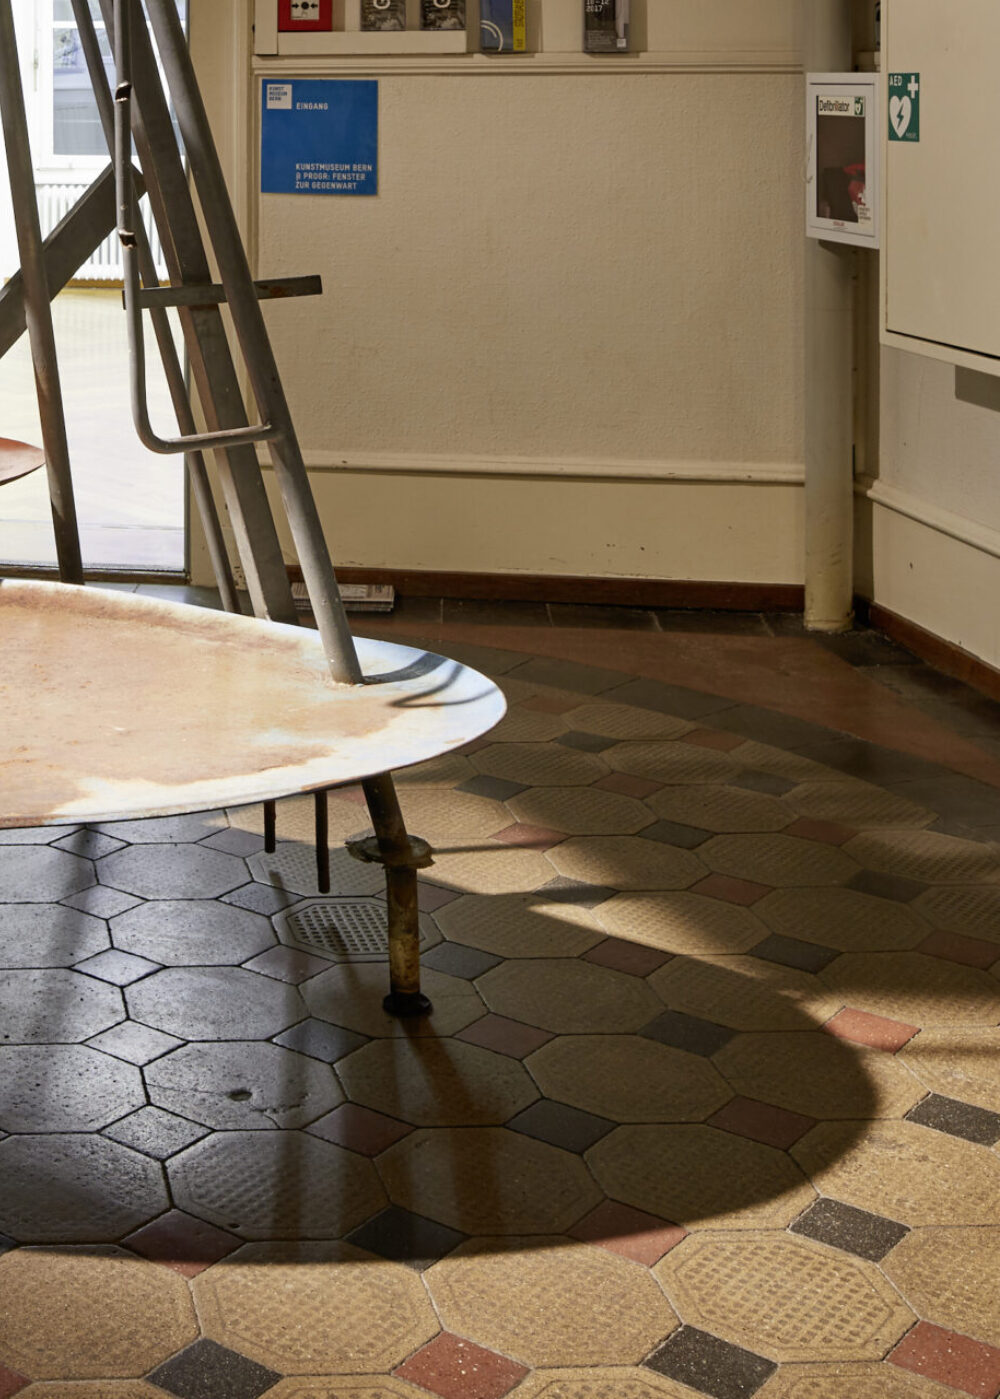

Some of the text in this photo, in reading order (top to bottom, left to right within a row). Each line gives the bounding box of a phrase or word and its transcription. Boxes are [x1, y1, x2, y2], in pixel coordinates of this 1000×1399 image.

[889, 75, 903, 86] AED
[296, 102, 329, 111] EINGANG
[819, 99, 850, 112] Defibrillator
[295, 163, 373, 172] KUNSTMUSEUM BERN
[332, 172, 366, 181] FENSTER
[295, 181, 357, 190] ZUR GEGENWART
